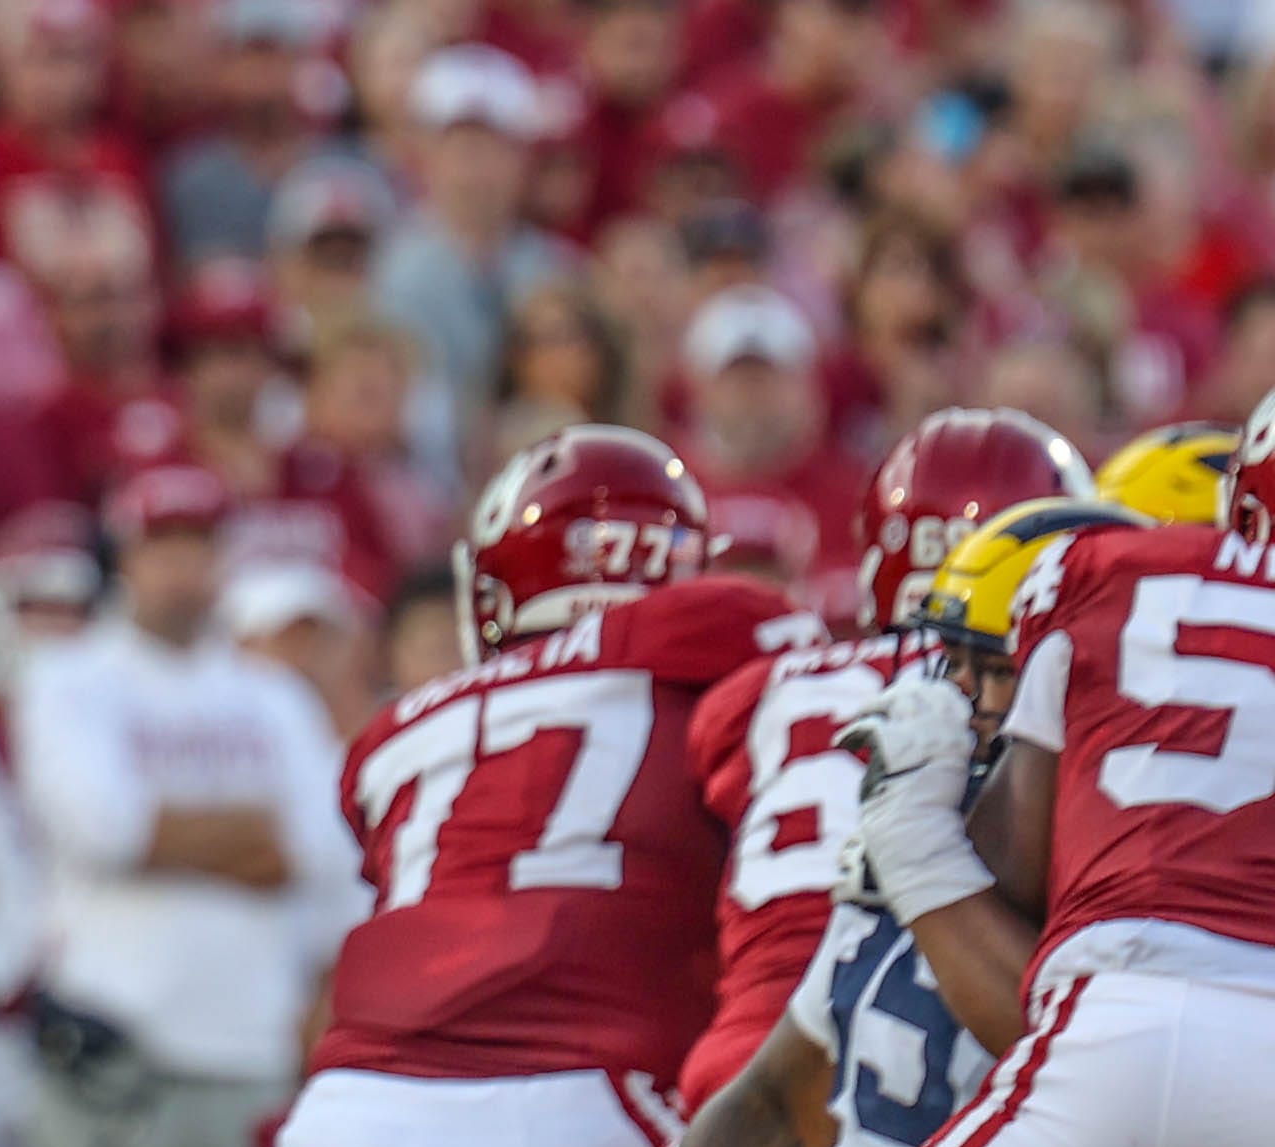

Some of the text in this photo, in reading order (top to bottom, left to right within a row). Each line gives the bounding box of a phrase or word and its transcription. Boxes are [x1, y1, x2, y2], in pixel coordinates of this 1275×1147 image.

[598, 519, 673, 580] 77
[354, 667, 655, 913] 77
[728, 658, 883, 913] 6
